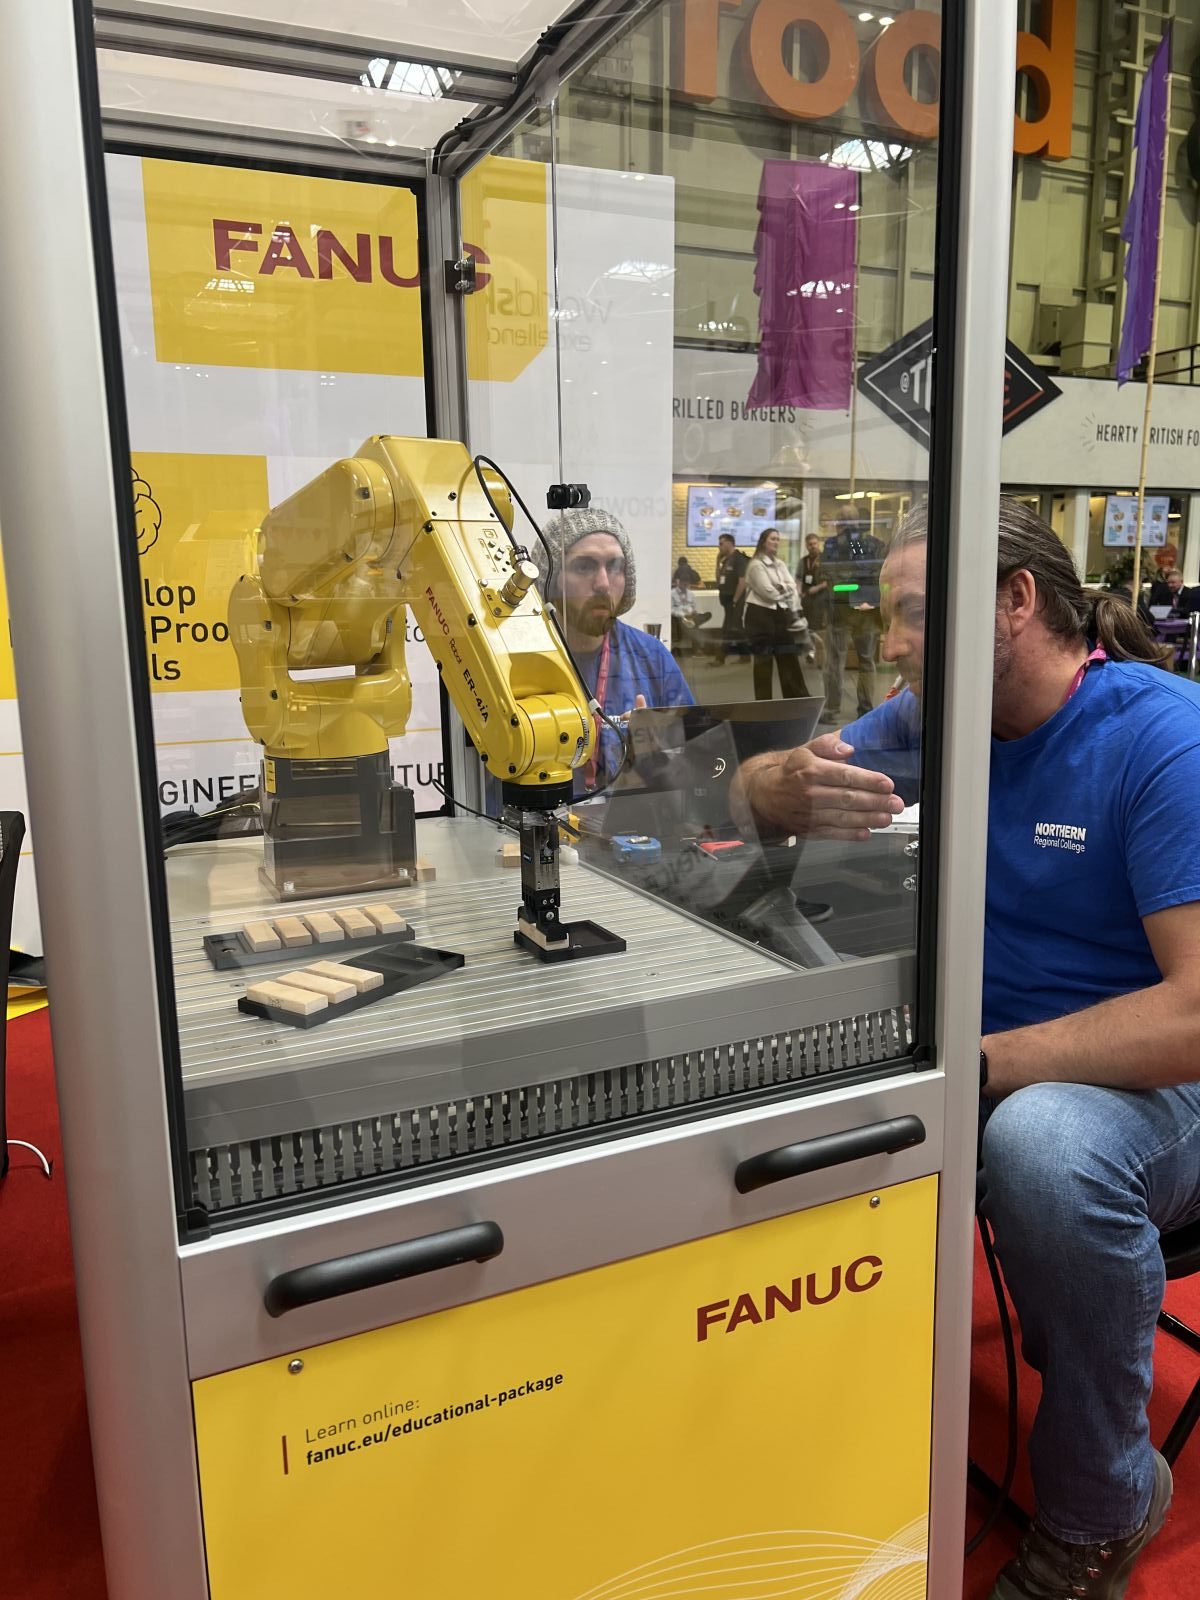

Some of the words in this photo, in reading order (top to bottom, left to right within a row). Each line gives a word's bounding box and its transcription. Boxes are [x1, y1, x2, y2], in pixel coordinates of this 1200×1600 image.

[672, 398, 725, 420] RILLED
[730, 401, 796, 424] BURGERS
[1096, 424, 1138, 443] HEARTY
[1149, 427, 1184, 446] RITISH
[1186, 429, 1200, 447] FO
[144, 578, 196, 614] lop
[425, 586, 450, 636] FANUC
[150, 615, 229, 644] Proo
[151, 653, 181, 681] ls
[1033, 835, 1060, 848] Regional
[1060, 838, 1086, 854] College
[1035, 822, 1087, 842] NORTHERN
[697, 1255, 883, 1342] FANUC
[305, 1416, 357, 1443] Learn
[362, 1399, 420, 1426] online:
[306, 1372, 564, 1466] fanuc.eu/educational-package
